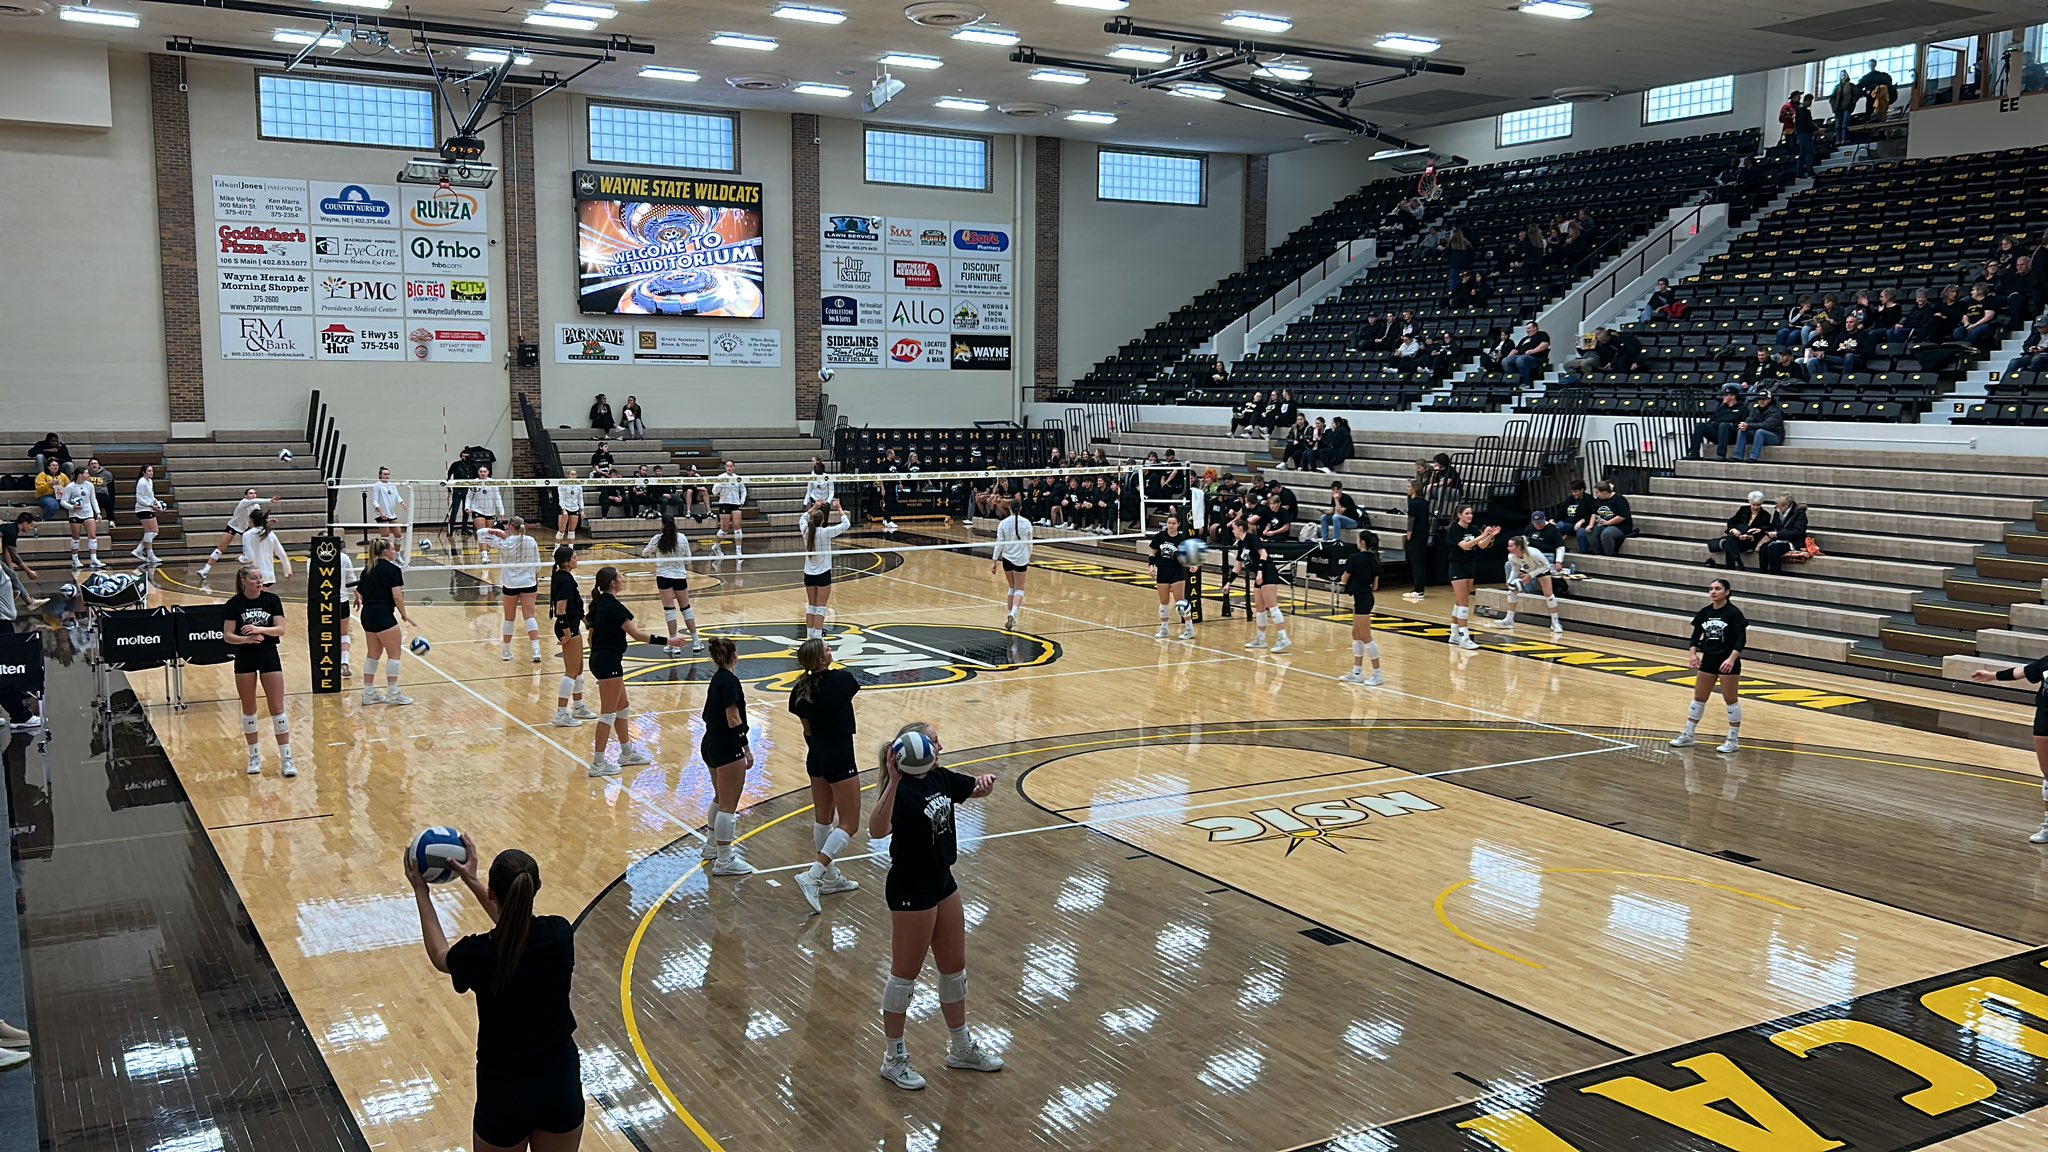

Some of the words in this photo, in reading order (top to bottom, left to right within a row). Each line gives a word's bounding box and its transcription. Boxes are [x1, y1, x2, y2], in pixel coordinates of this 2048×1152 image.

[2000, 98, 2019, 112] EE
[600, 176, 649, 195] WAYNE
[652, 180, 690, 199] STATE
[694, 183, 759, 203] WILDCATS
[324, 203, 355, 211] COUNTRY
[356, 205, 385, 213] NURSERY
[417, 200, 471, 220] RUNZA
[219, 225, 306, 242] Godfather's
[890, 228, 912, 237] MAX
[344, 244, 395, 258] EyeCare
[436, 241, 480, 258] fnbo
[614, 241, 685, 264] WELCOME
[693, 232, 722, 250] TO
[605, 263, 630, 277] RICE
[631, 246, 756, 275] AUDITORIUM
[845, 256, 863, 270] Our
[962, 262, 1000, 272] DISCOUNT
[223, 273, 257, 282] Wayne
[260, 274, 294, 282] Herald
[841, 268, 871, 282] Savior
[896, 269, 930, 277] NEBRASKA
[960, 272, 1002, 282] FURNITURE
[221, 282, 266, 292] Morning
[269, 284, 309, 292] Shopper
[348, 282, 397, 300] PMC
[407, 282, 423, 298] BIG
[427, 283, 445, 298] RED
[413, 308, 483, 316] www.WayneDailyNews.com
[825, 307, 854, 315] COBBLESTONE
[892, 300, 944, 324] Allo
[321, 333, 354, 344] Pizza
[368, 331, 386, 340] Hwy
[388, 331, 398, 339] 35
[562, 328, 584, 344] PAC
[597, 329, 624, 346] SAVE
[266, 340, 296, 349] Bank
[361, 342, 399, 350] 375-2540
[827, 336, 878, 347] SIDELINES
[324, 343, 349, 354] Hut
[896, 344, 918, 358] DQ
[973, 347, 1009, 357] WAYNE
[1990, 372, 1999, 380] 3
[1956, 404, 1963, 412] 2
[318, 567, 335, 624] WAYNE
[116, 635, 161, 646] molten
[189, 630, 224, 641] molte
[320, 632, 334, 688] STATE
[1182, 790, 1444, 842] NSIC
